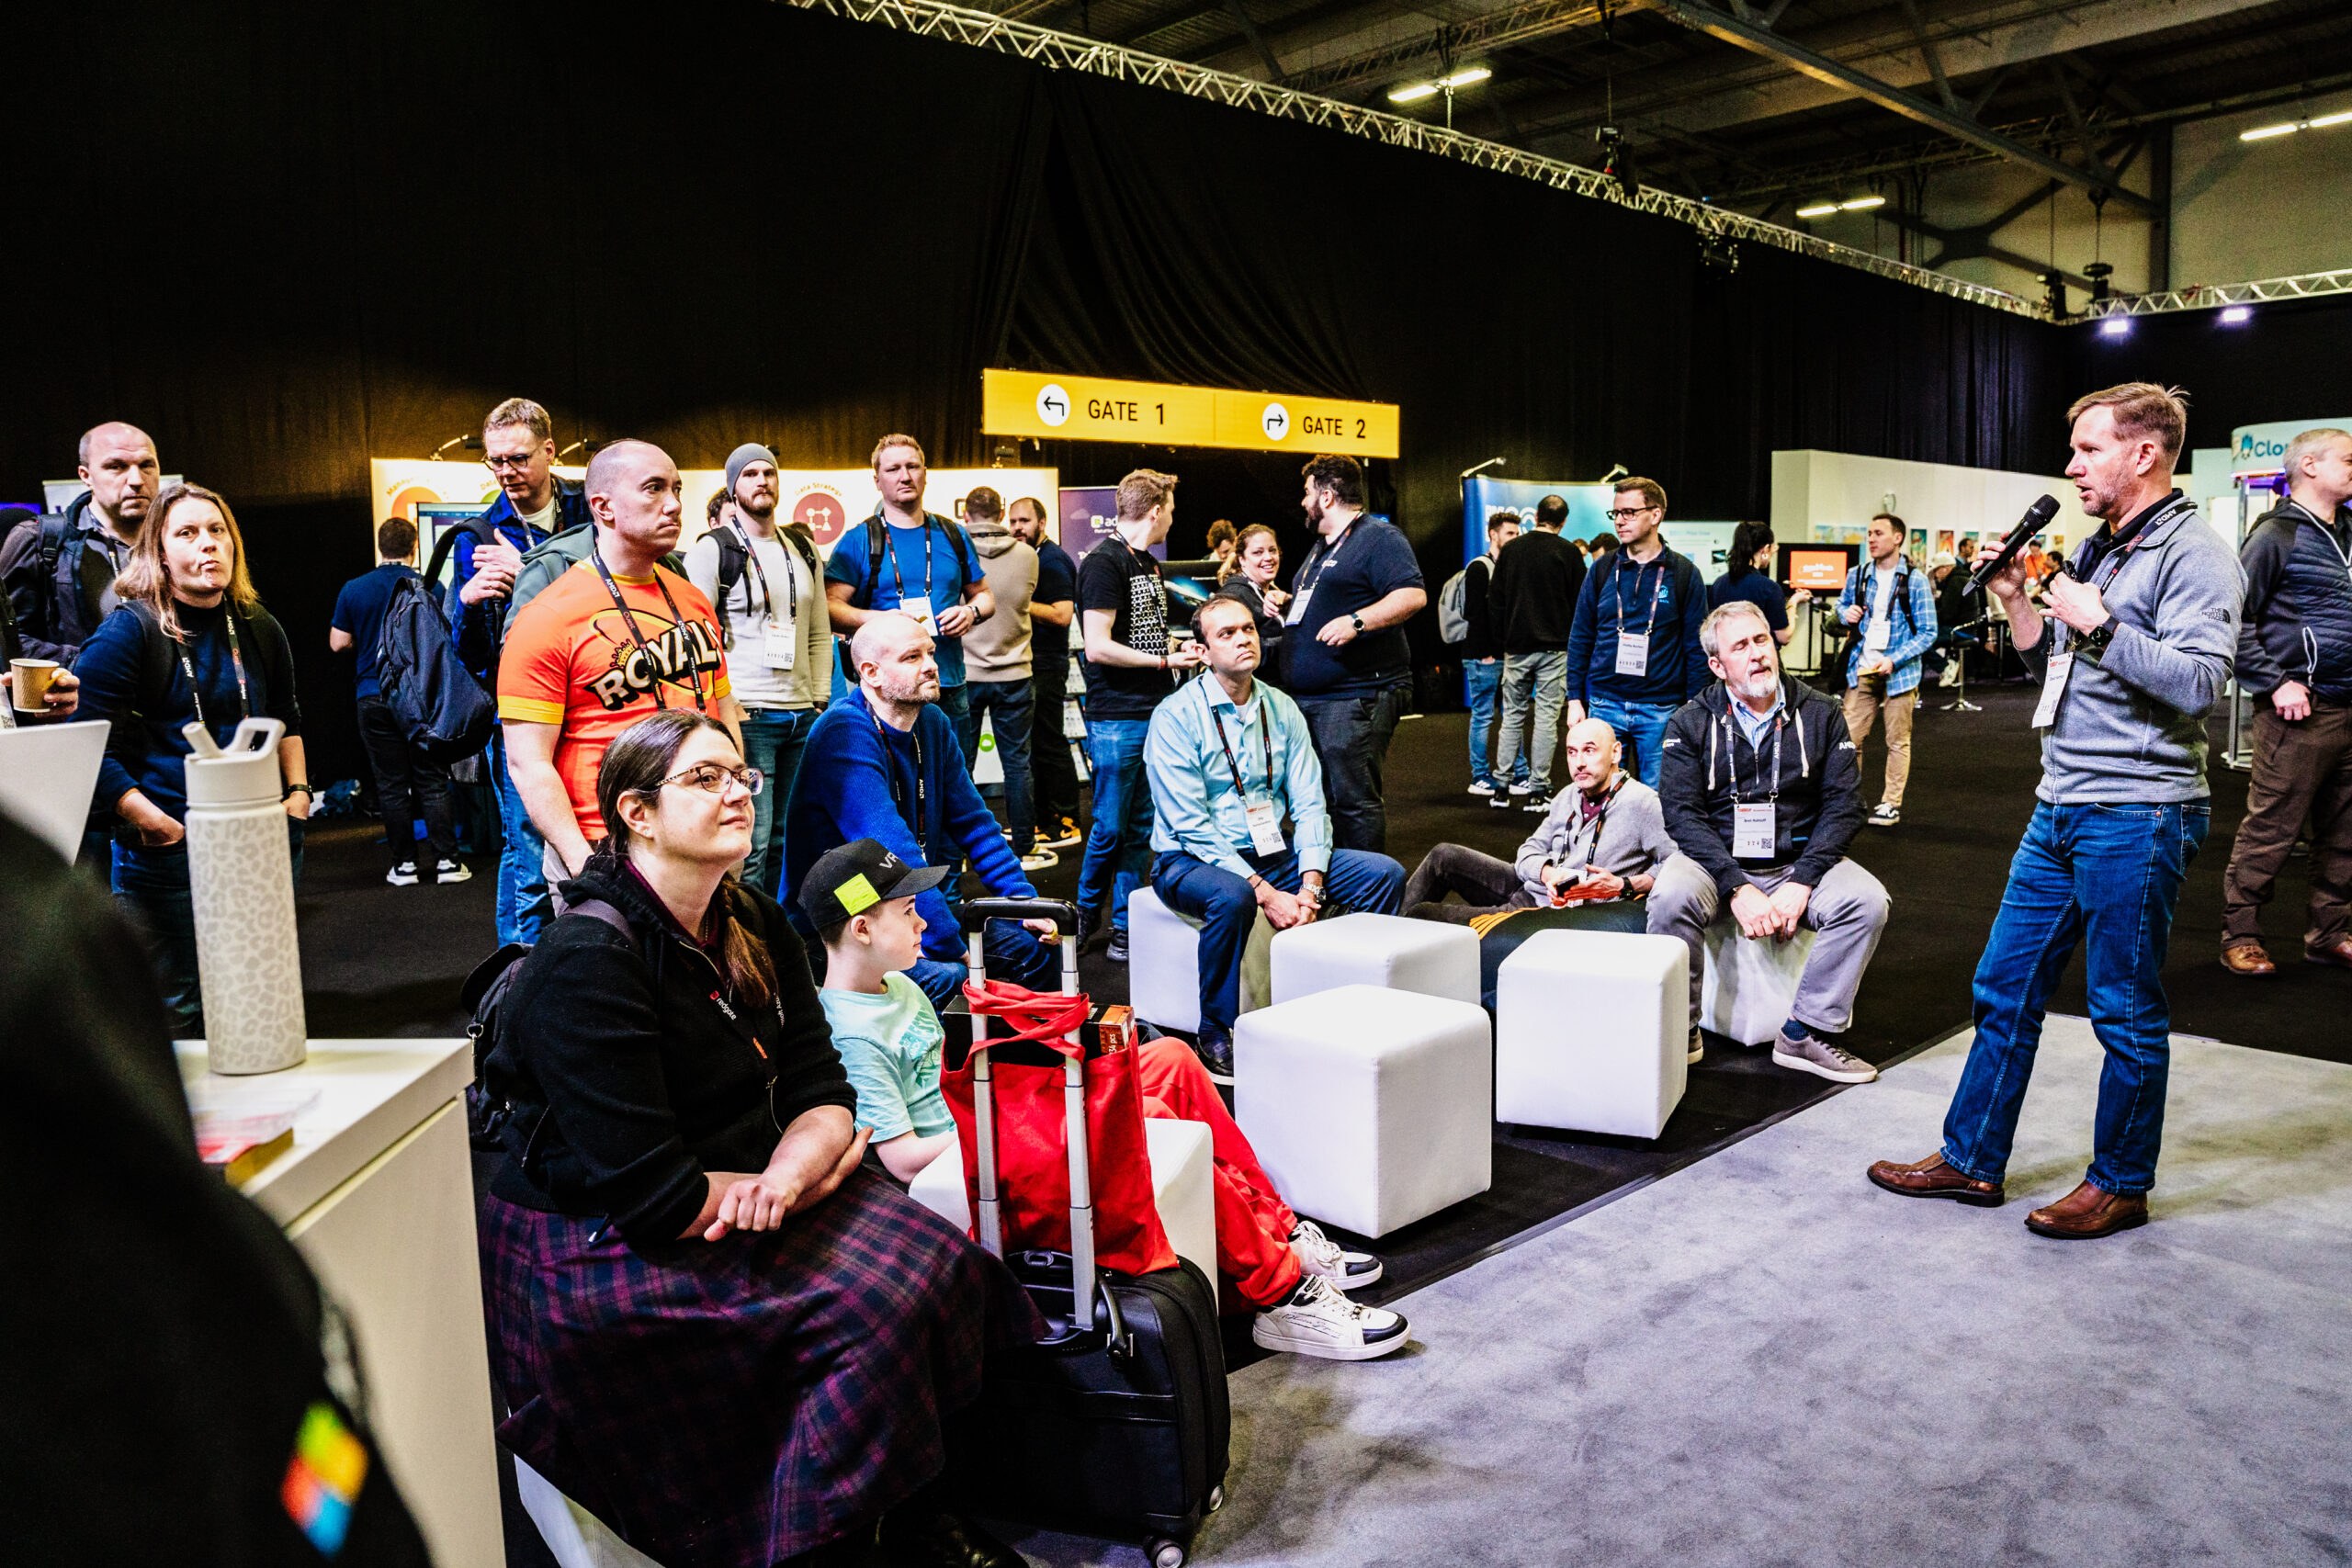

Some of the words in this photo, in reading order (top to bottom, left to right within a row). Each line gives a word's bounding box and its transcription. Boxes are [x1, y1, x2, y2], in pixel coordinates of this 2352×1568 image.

[1088, 400, 1138, 422] GATE
[1155, 403, 1165, 425] 1
[1302, 416, 1343, 435] GATE
[1356, 419, 1366, 439] 2
[2255, 440, 2289, 457] Clo
[2160, 509, 2177, 525] AMD
[605, 579, 619, 596] AMD
[623, 611, 636, 629] Quest
[679, 622, 690, 641] AMD
[183, 659, 194, 678] AMD
[590, 619, 722, 706] ROYALS
[717, 998, 737, 1021] redgate
